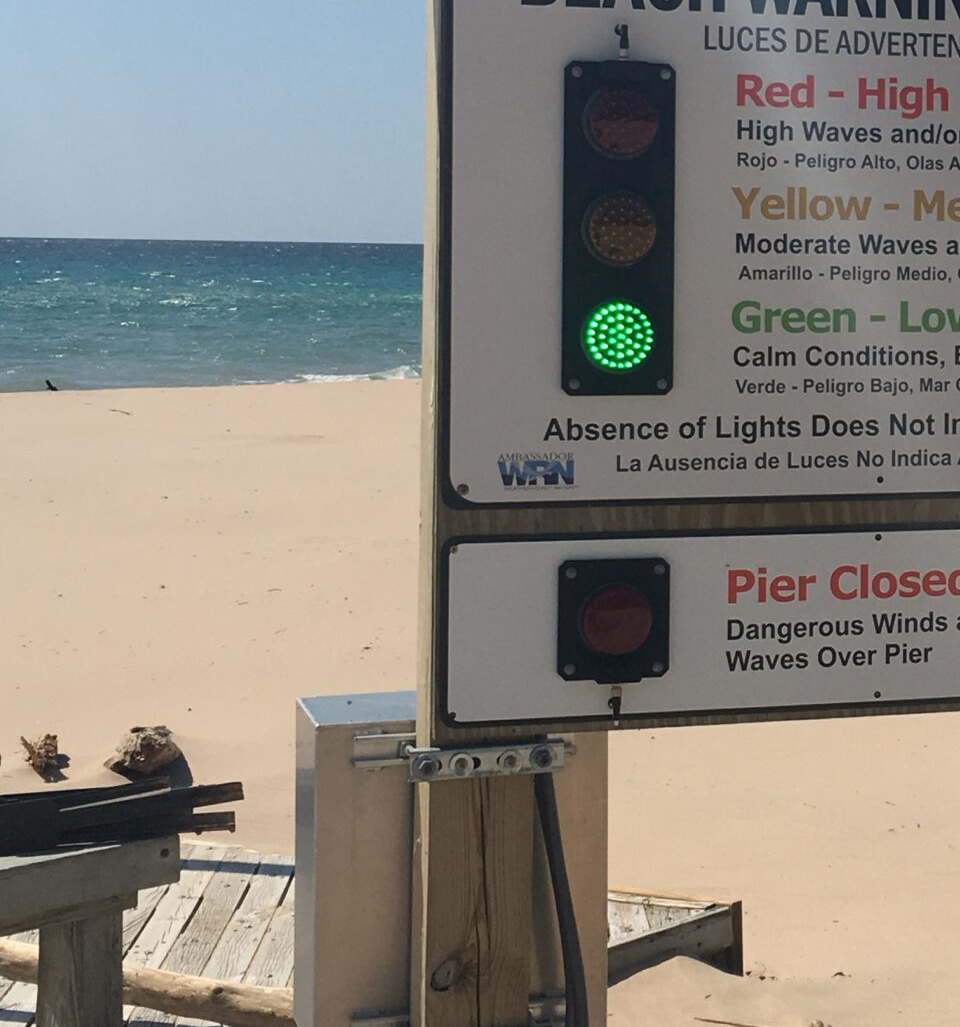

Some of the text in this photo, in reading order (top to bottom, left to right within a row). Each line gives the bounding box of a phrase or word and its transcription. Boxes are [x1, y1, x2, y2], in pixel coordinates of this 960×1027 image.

[705, 26, 786, 52] LUCES
[796, 29, 829, 53] DE
[737, 74, 814, 108] Red
[827, 90, 845, 99] -
[859, 77, 948, 119] High
[737, 120, 793, 146] High
[802, 121, 882, 142] Waves
[737, 152, 777, 171] Rojo
[795, 153, 856, 172] Peligro
[861, 155, 900, 171] Alto,
[907, 156, 944, 170] Olas
[731, 187, 872, 221] Yellow
[883, 203, 900, 211] -
[736, 233, 850, 254] Moderate
[859, 234, 937, 255] Waves
[739, 266, 812, 280] Amarillo
[830, 266, 890, 284] Peligro
[897, 266, 951, 283] Medio,
[732, 301, 856, 334] Green
[869, 314, 886, 323] -
[734, 346, 796, 367] Calm
[806, 346, 944, 369] Conditions,
[735, 379, 785, 394] Verde
[804, 379, 864, 397] Peligro
[871, 378, 913, 396] Bajo,
[920, 378, 950, 392] Mar
[544, 418, 668, 441] Absence
[679, 416, 707, 439] of
[716, 415, 801, 444] Lights
[812, 415, 879, 437] Does
[890, 413, 935, 435] Not
[498, 451, 574, 462] AMBASSADOR
[617, 455, 641, 472] La
[648, 453, 747, 471] Ausencia
[755, 452, 779, 469] de
[788, 452, 848, 469] Luces
[857, 450, 884, 467] No
[892, 449, 951, 466] Indica
[497, 460, 575, 486] WRN
[727, 566, 816, 604] Pier
[727, 620, 864, 644] Dangerous
[872, 612, 948, 634] Winds
[726, 643, 933, 671] Waves Over Pier
